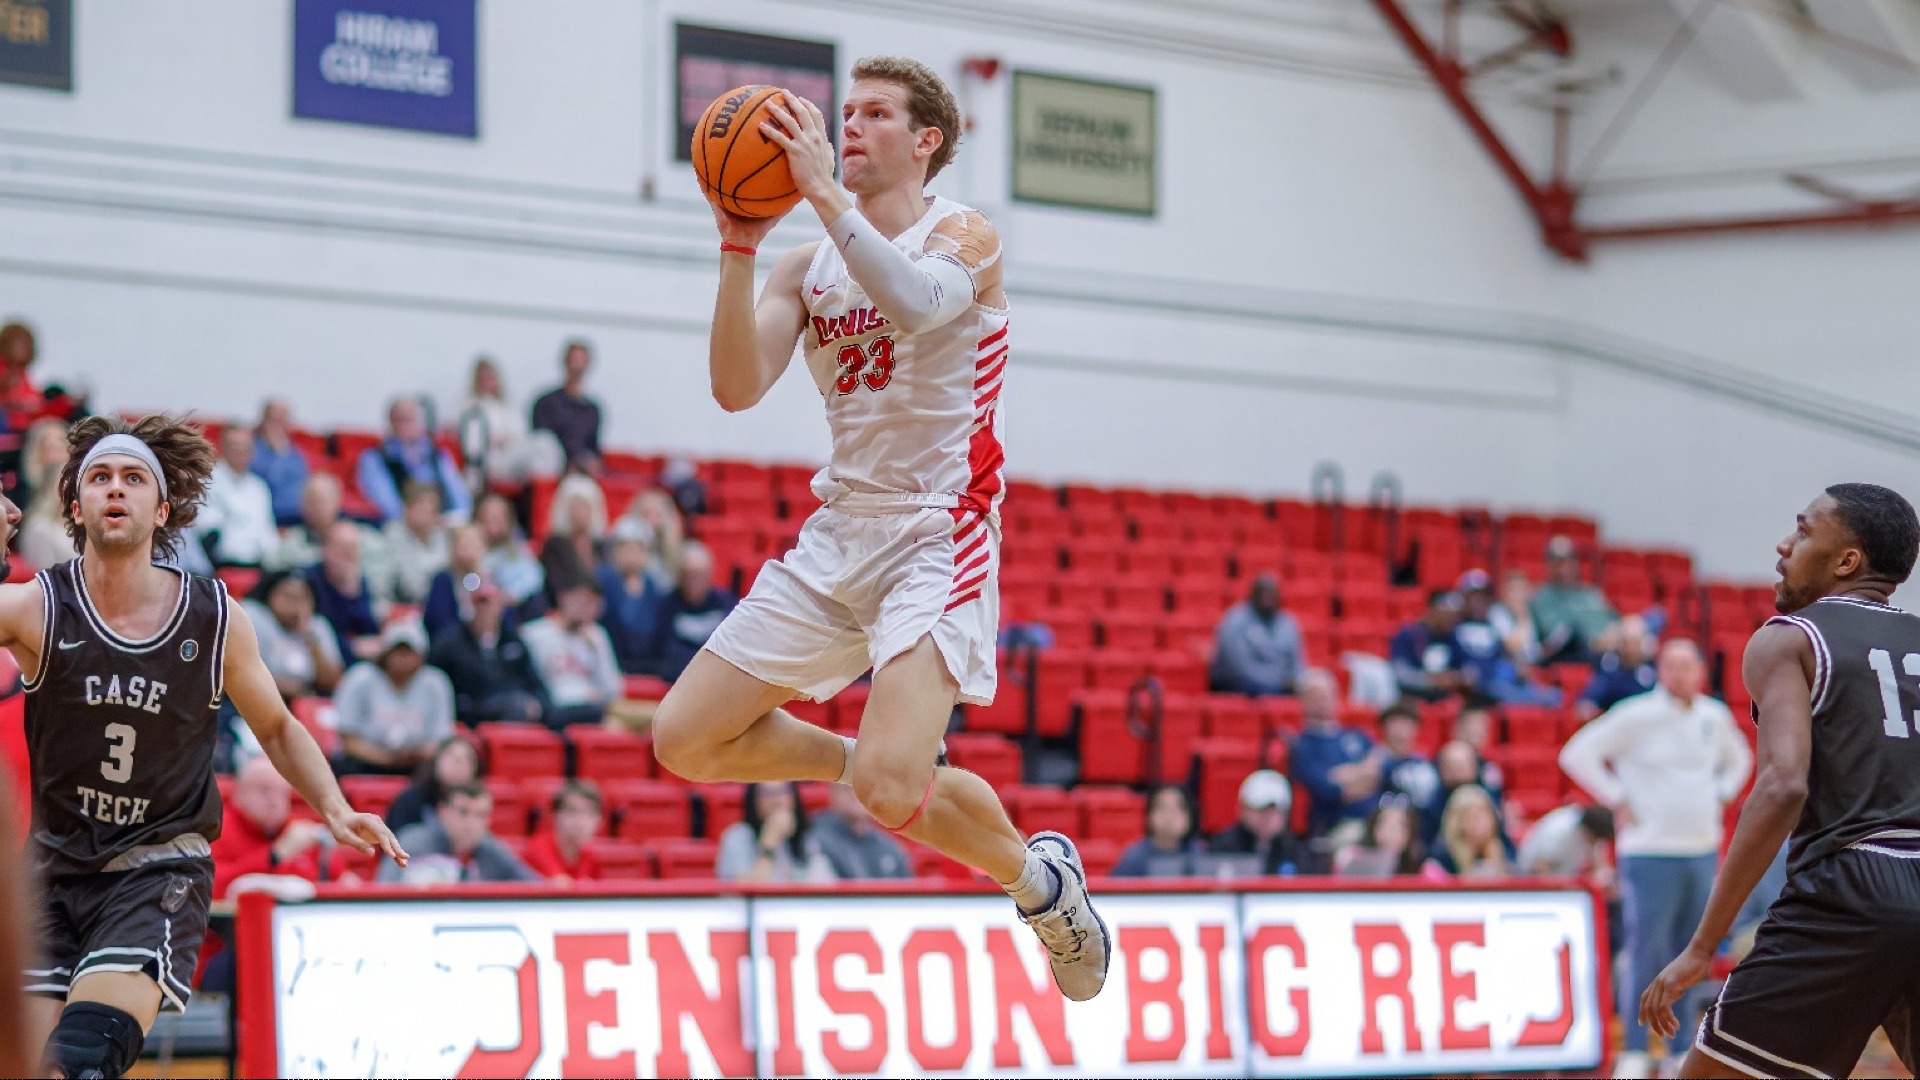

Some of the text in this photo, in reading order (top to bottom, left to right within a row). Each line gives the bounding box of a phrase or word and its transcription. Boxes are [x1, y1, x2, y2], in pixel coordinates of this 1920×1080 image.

[335, 9, 439, 54] HIRAM
[319, 41, 454, 97] COLLEGE
[811, 305, 891, 348] DNIS
[838, 336, 896, 396] 33
[85, 674, 168, 714] CASE
[101, 722, 136, 783] 3
[77, 785, 150, 825] TECH
[434, 922, 1075, 1079] DENISON
[1118, 923, 1311, 1063] BIG
[1354, 914, 1574, 1056] RED
